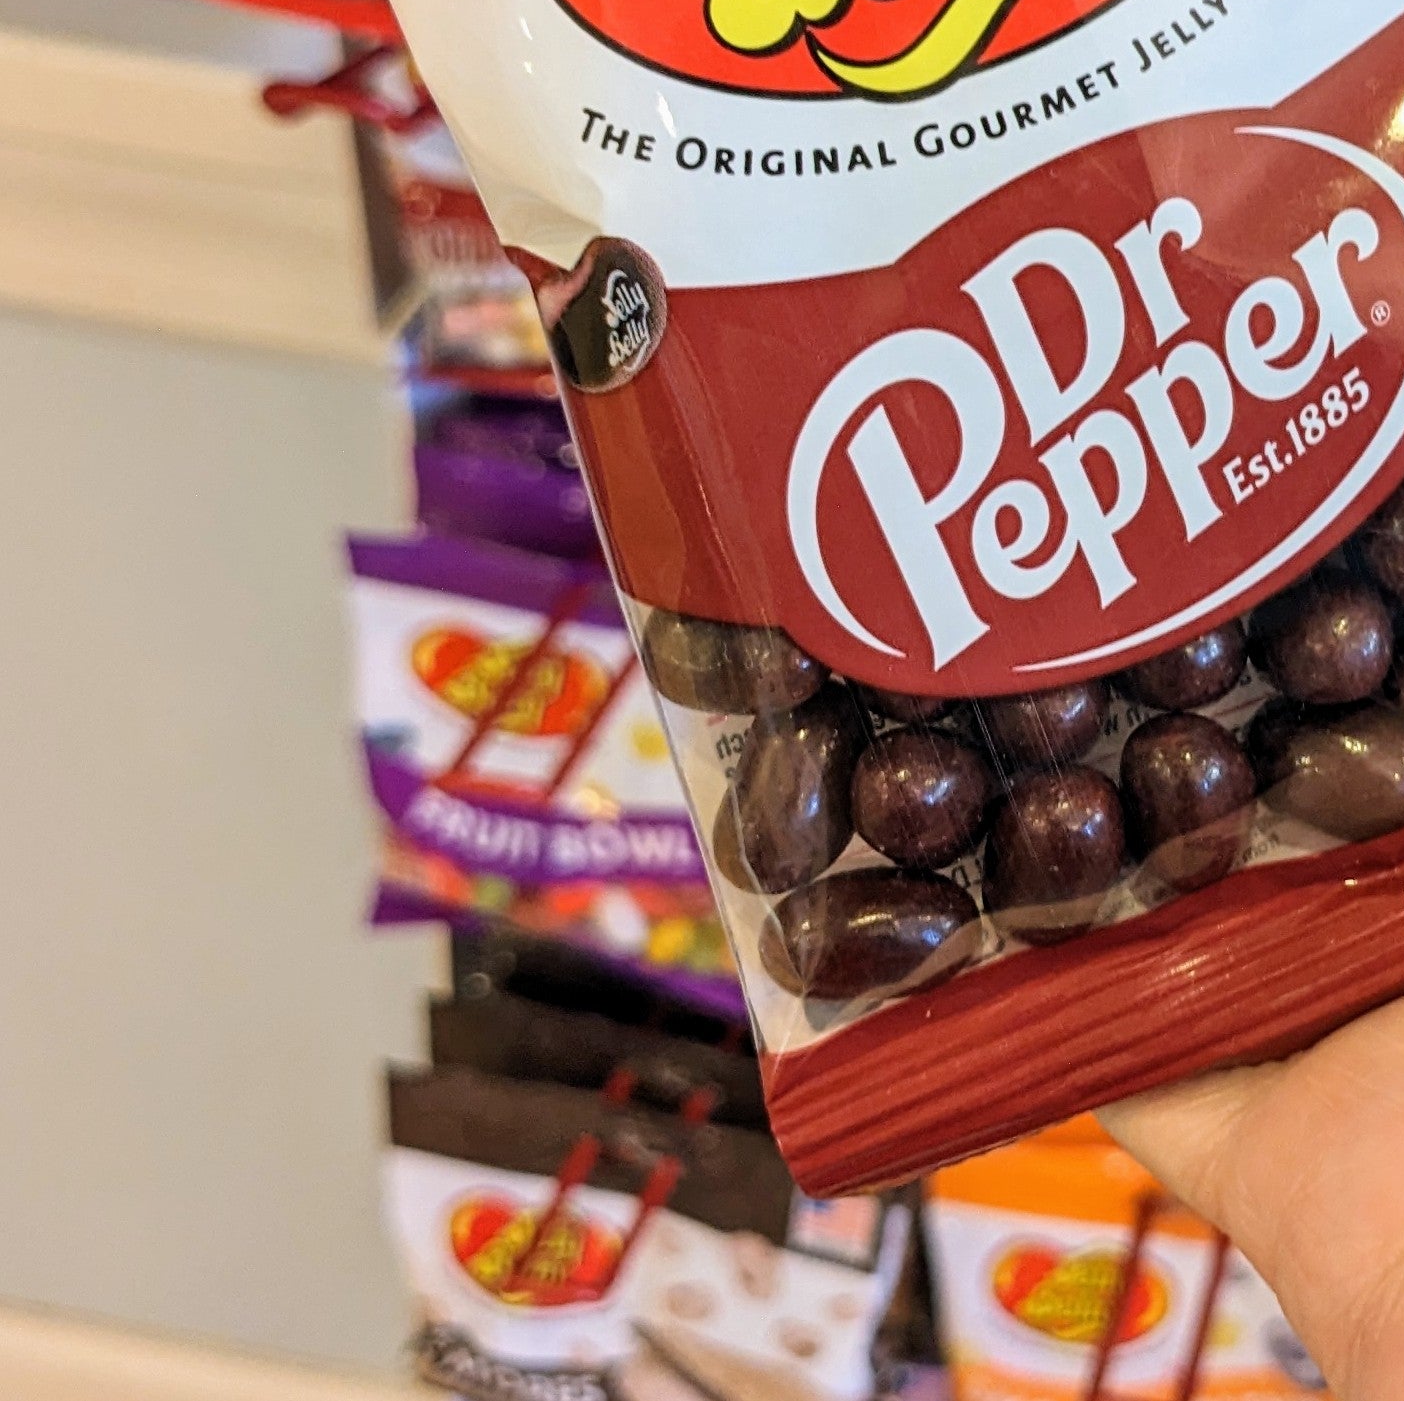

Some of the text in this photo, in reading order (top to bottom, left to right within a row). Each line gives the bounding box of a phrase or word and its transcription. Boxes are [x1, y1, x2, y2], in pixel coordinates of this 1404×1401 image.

[582, 107, 657, 163] THE
[675, 136, 898, 177] ORIGINAL
[912, 61, 1121, 159] GOURMET
[601, 269, 651, 329] Jelly
[960, 196, 1203, 449] Dr
[786, 205, 1381, 673] Pepper
[1220, 366, 1371, 504] Est.1885
